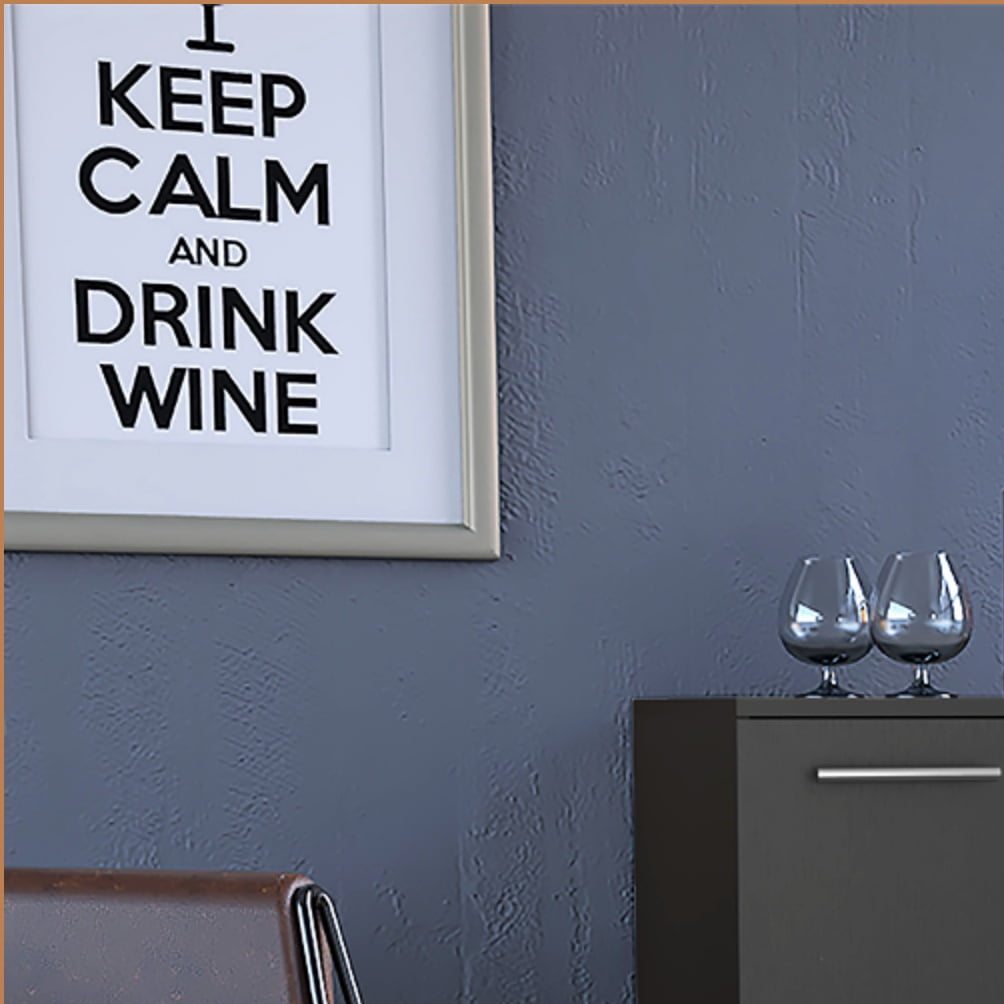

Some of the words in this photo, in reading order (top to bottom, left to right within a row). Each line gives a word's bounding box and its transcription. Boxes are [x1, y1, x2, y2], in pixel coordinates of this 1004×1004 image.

[98, 61, 307, 138] KEEP
[79, 146, 331, 226] CALM
[168, 236, 248, 268] AND
[74, 278, 340, 356] DRINK
[99, 363, 320, 436] WINE
